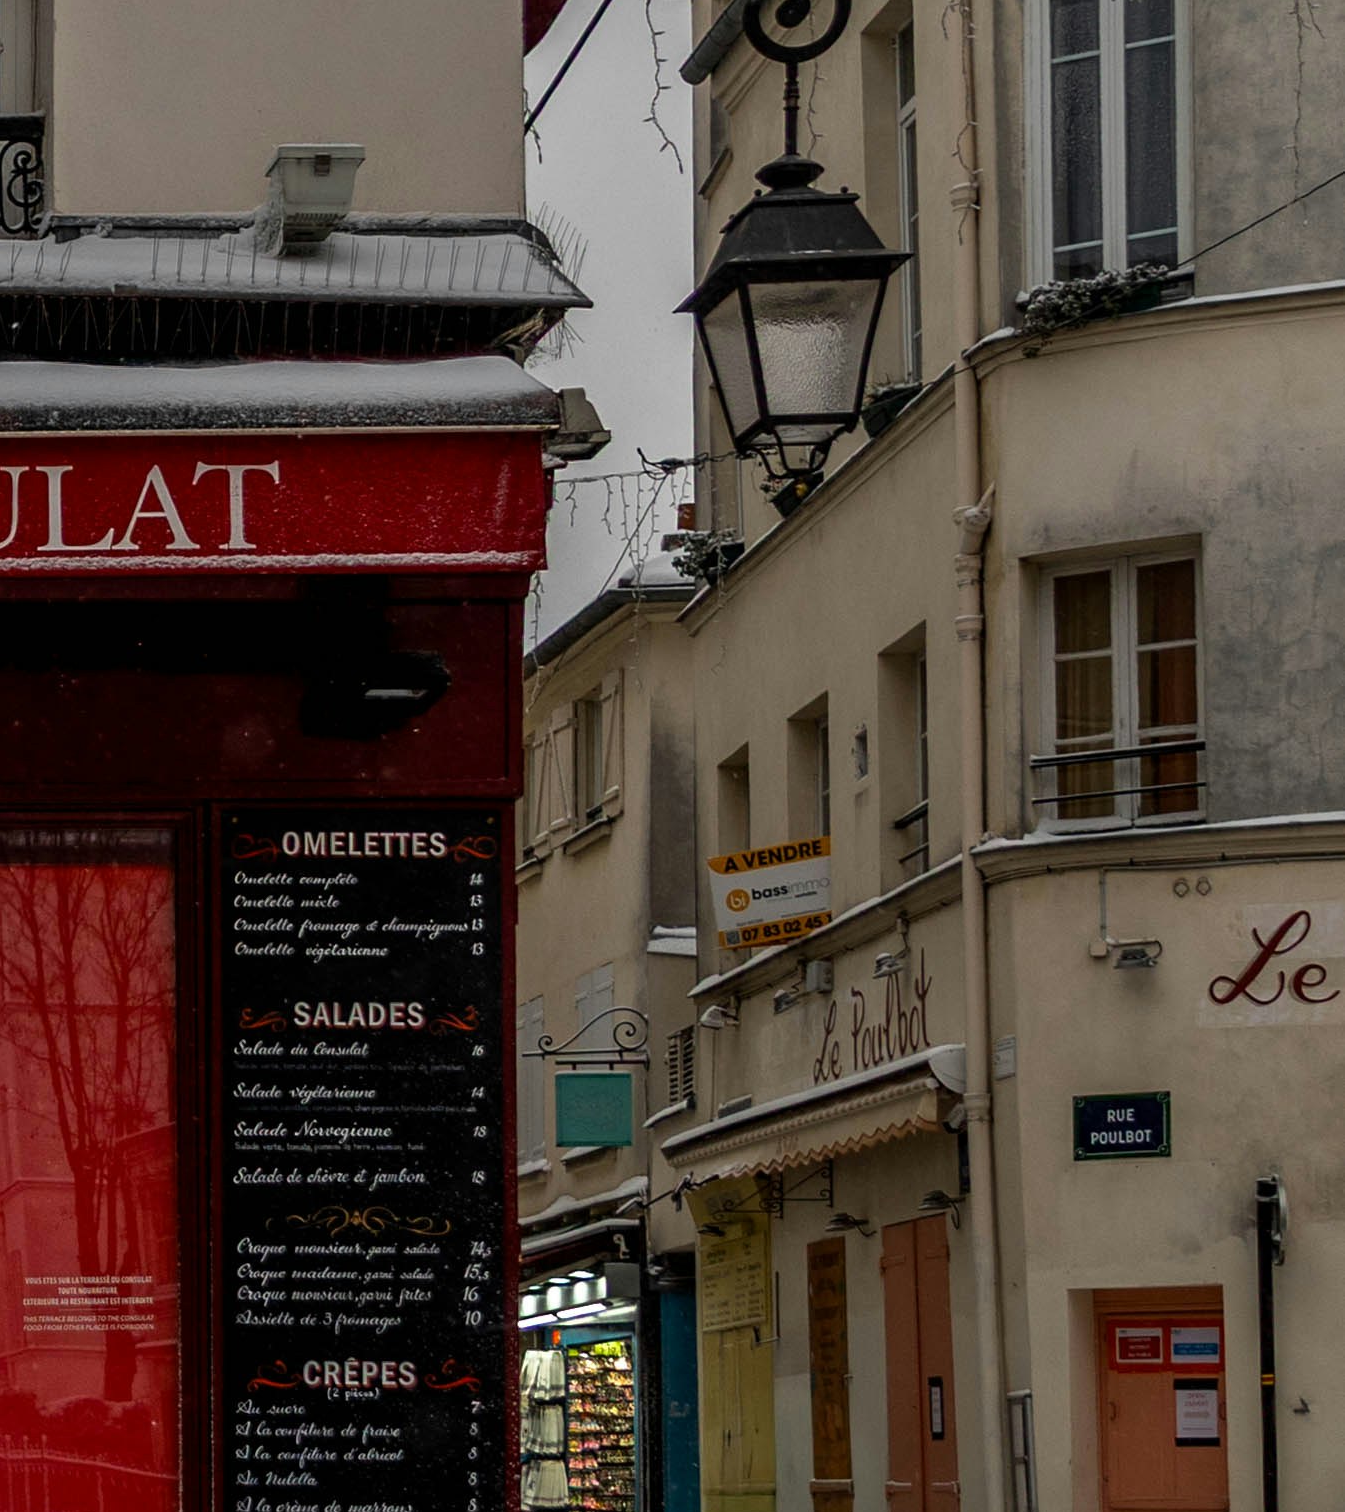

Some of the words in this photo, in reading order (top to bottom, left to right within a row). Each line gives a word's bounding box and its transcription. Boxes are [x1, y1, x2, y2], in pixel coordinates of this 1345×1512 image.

[282, 831, 446, 856] OMELETTES
[741, 840, 822, 868] VENDRE
[234, 871, 294, 885] Omelette
[469, 873, 483, 885] 14
[233, 895, 294, 908] Omelette
[233, 918, 294, 931] Omelette
[298, 919, 360, 940] fromage
[382, 916, 468, 940] champignons
[742, 929, 759, 942] 07
[763, 925, 780, 937] 83
[783, 920, 800, 933] 02
[805, 916, 823, 929] 45
[234, 942, 295, 956] Omelette
[1208, 910, 1340, 1005] Le
[294, 1001, 423, 1027] SALADES
[233, 1039, 283, 1056] Salade
[291, 1041, 307, 1055] du
[313, 1040, 369, 1056] Consulat
[472, 1045, 484, 1056] 16
[813, 1000, 842, 1084] Le
[233, 1082, 282, 1098] Salade
[471, 1087, 484, 1098] 14
[1107, 1108, 1135, 1123] RUE
[233, 1121, 288, 1137] Salade
[1091, 1129, 1152, 1145] POULBOT
[233, 1167, 282, 1184] Salade
[286, 1168, 302, 1183] de
[307, 1167, 350, 1183] chèvre
[354, 1167, 367, 1183] et
[369, 1168, 425, 1191] jambon
[237, 1237, 286, 1262] Croque
[368, 1242, 397, 1260] garni
[404, 1243, 441, 1254] salade
[237, 1262, 285, 1286] Croque
[400, 1269, 434, 1280] salade
[237, 1285, 287, 1307] Croque
[395, 1286, 432, 1307] frites
[462, 1286, 478, 1301] 16
[235, 1310, 295, 1325] Assiette
[300, 1310, 317, 1325] de
[321, 1310, 333, 1325] 3
[334, 1313, 402, 1334] fromages
[464, 1310, 481, 1325] 10
[303, 1356, 416, 1387] CRÊPES
[266, 1402, 306, 1414] sucre
[275, 1421, 334, 1445] confiture
[340, 1422, 355, 1437] de
[362, 1422, 400, 1446] fraise
[253, 1444, 270, 1461] la
[278, 1446, 336, 1469] confiture
[343, 1446, 403, 1461] d'abricot
[266, 1470, 318, 1486] Nutella
[256, 1496, 271, 1512] la
[276, 1498, 320, 1512] crème
[324, 1498, 341, 1512] de
